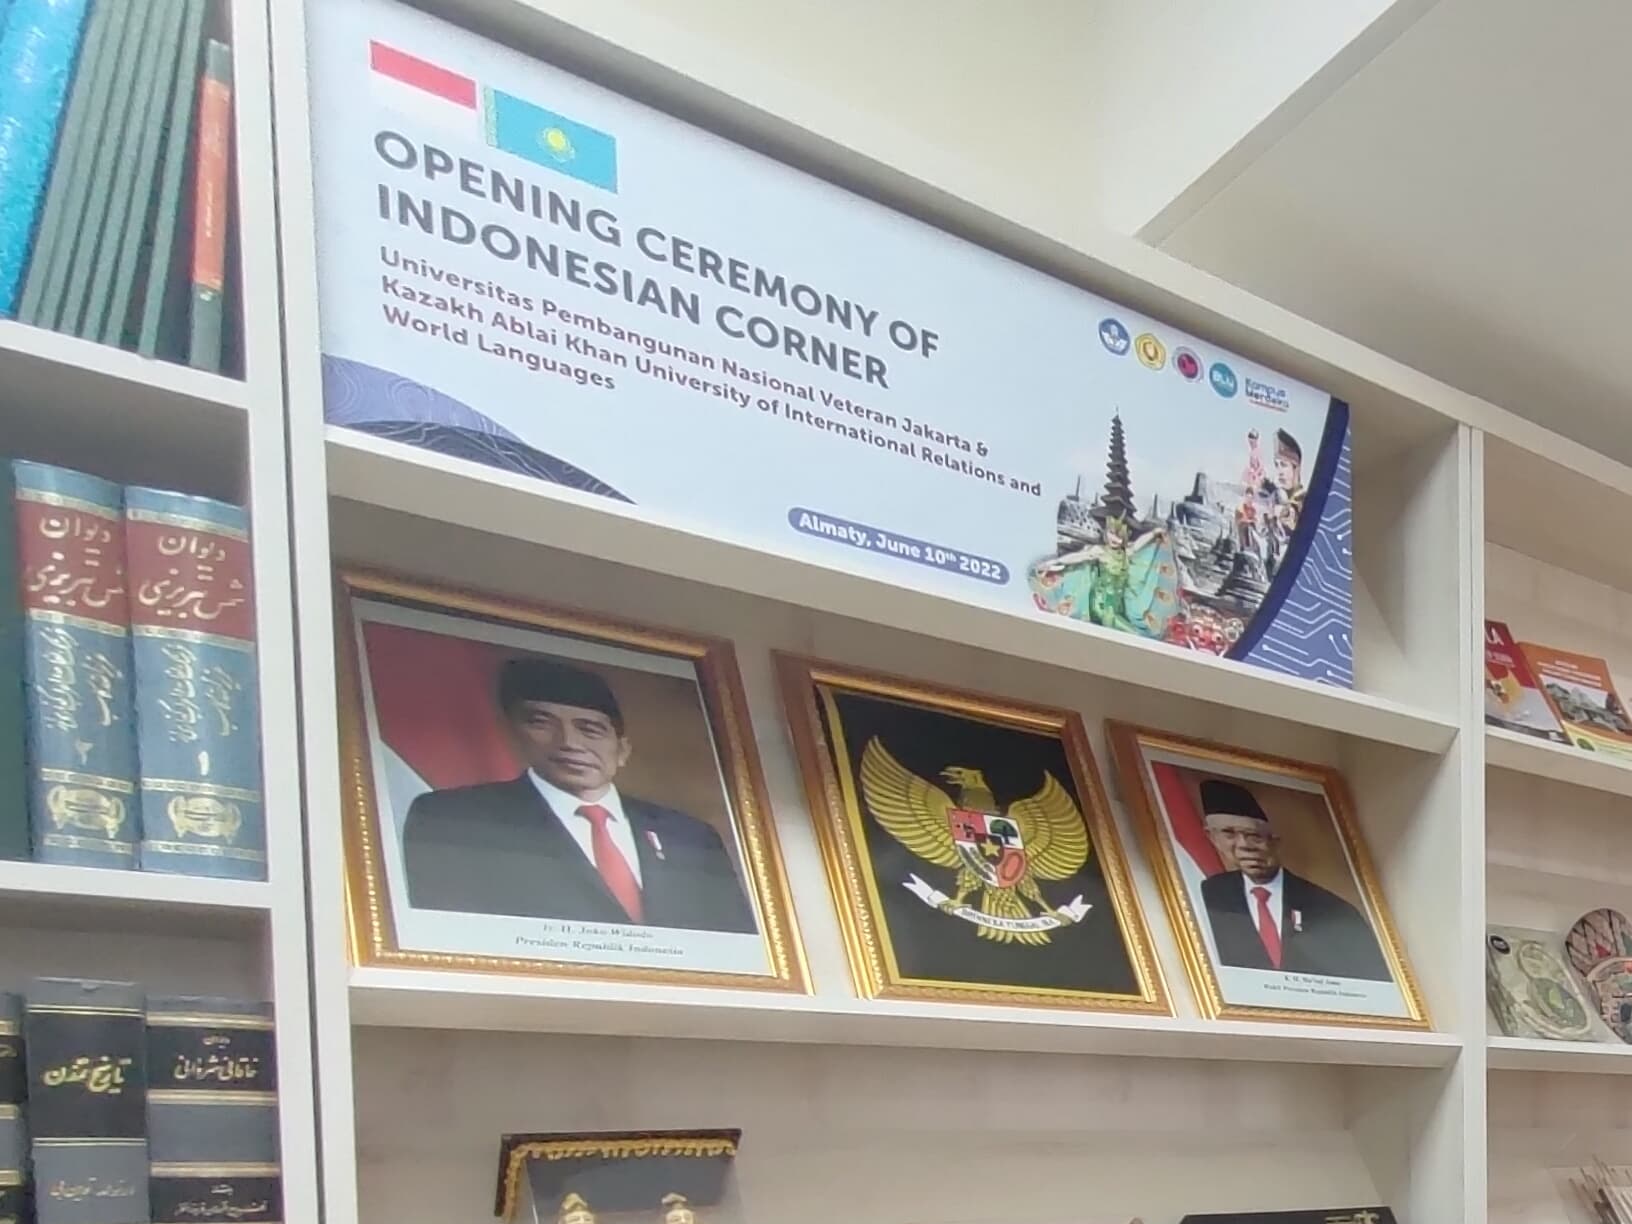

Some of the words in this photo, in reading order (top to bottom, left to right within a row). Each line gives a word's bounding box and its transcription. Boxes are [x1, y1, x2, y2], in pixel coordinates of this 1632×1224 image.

[374, 129, 622, 247] OPENING
[636, 227, 880, 338] CEREMONY
[888, 320, 940, 359] OF
[377, 184, 701, 324] INDONESIAN
[715, 306, 890, 389] CORNER
[382, 303, 469, 346] World
[477, 333, 616, 390] Languages
[380, 246, 534, 312] Universitas
[542, 299, 715, 370] Pembangunan
[722, 358, 815, 402] Nasional
[820, 389, 897, 428] Veteran
[902, 417, 971, 453] Jakarta
[976, 441, 989, 457] &
[381, 275, 485, 323] Kazakh
[491, 311, 557, 346] Ablai
[565, 333, 627, 368] Khan
[635, 355, 751, 408] University
[756, 398, 780, 415] of
[785, 403, 916, 458] International
[921, 446, 1006, 486] Relations
[1010, 476, 1042, 497] and
[799, 512, 872, 547] Almaty,
[875, 532, 921, 558] June
[924, 546, 957, 565] 10th
[959, 556, 1001, 580] 2022
